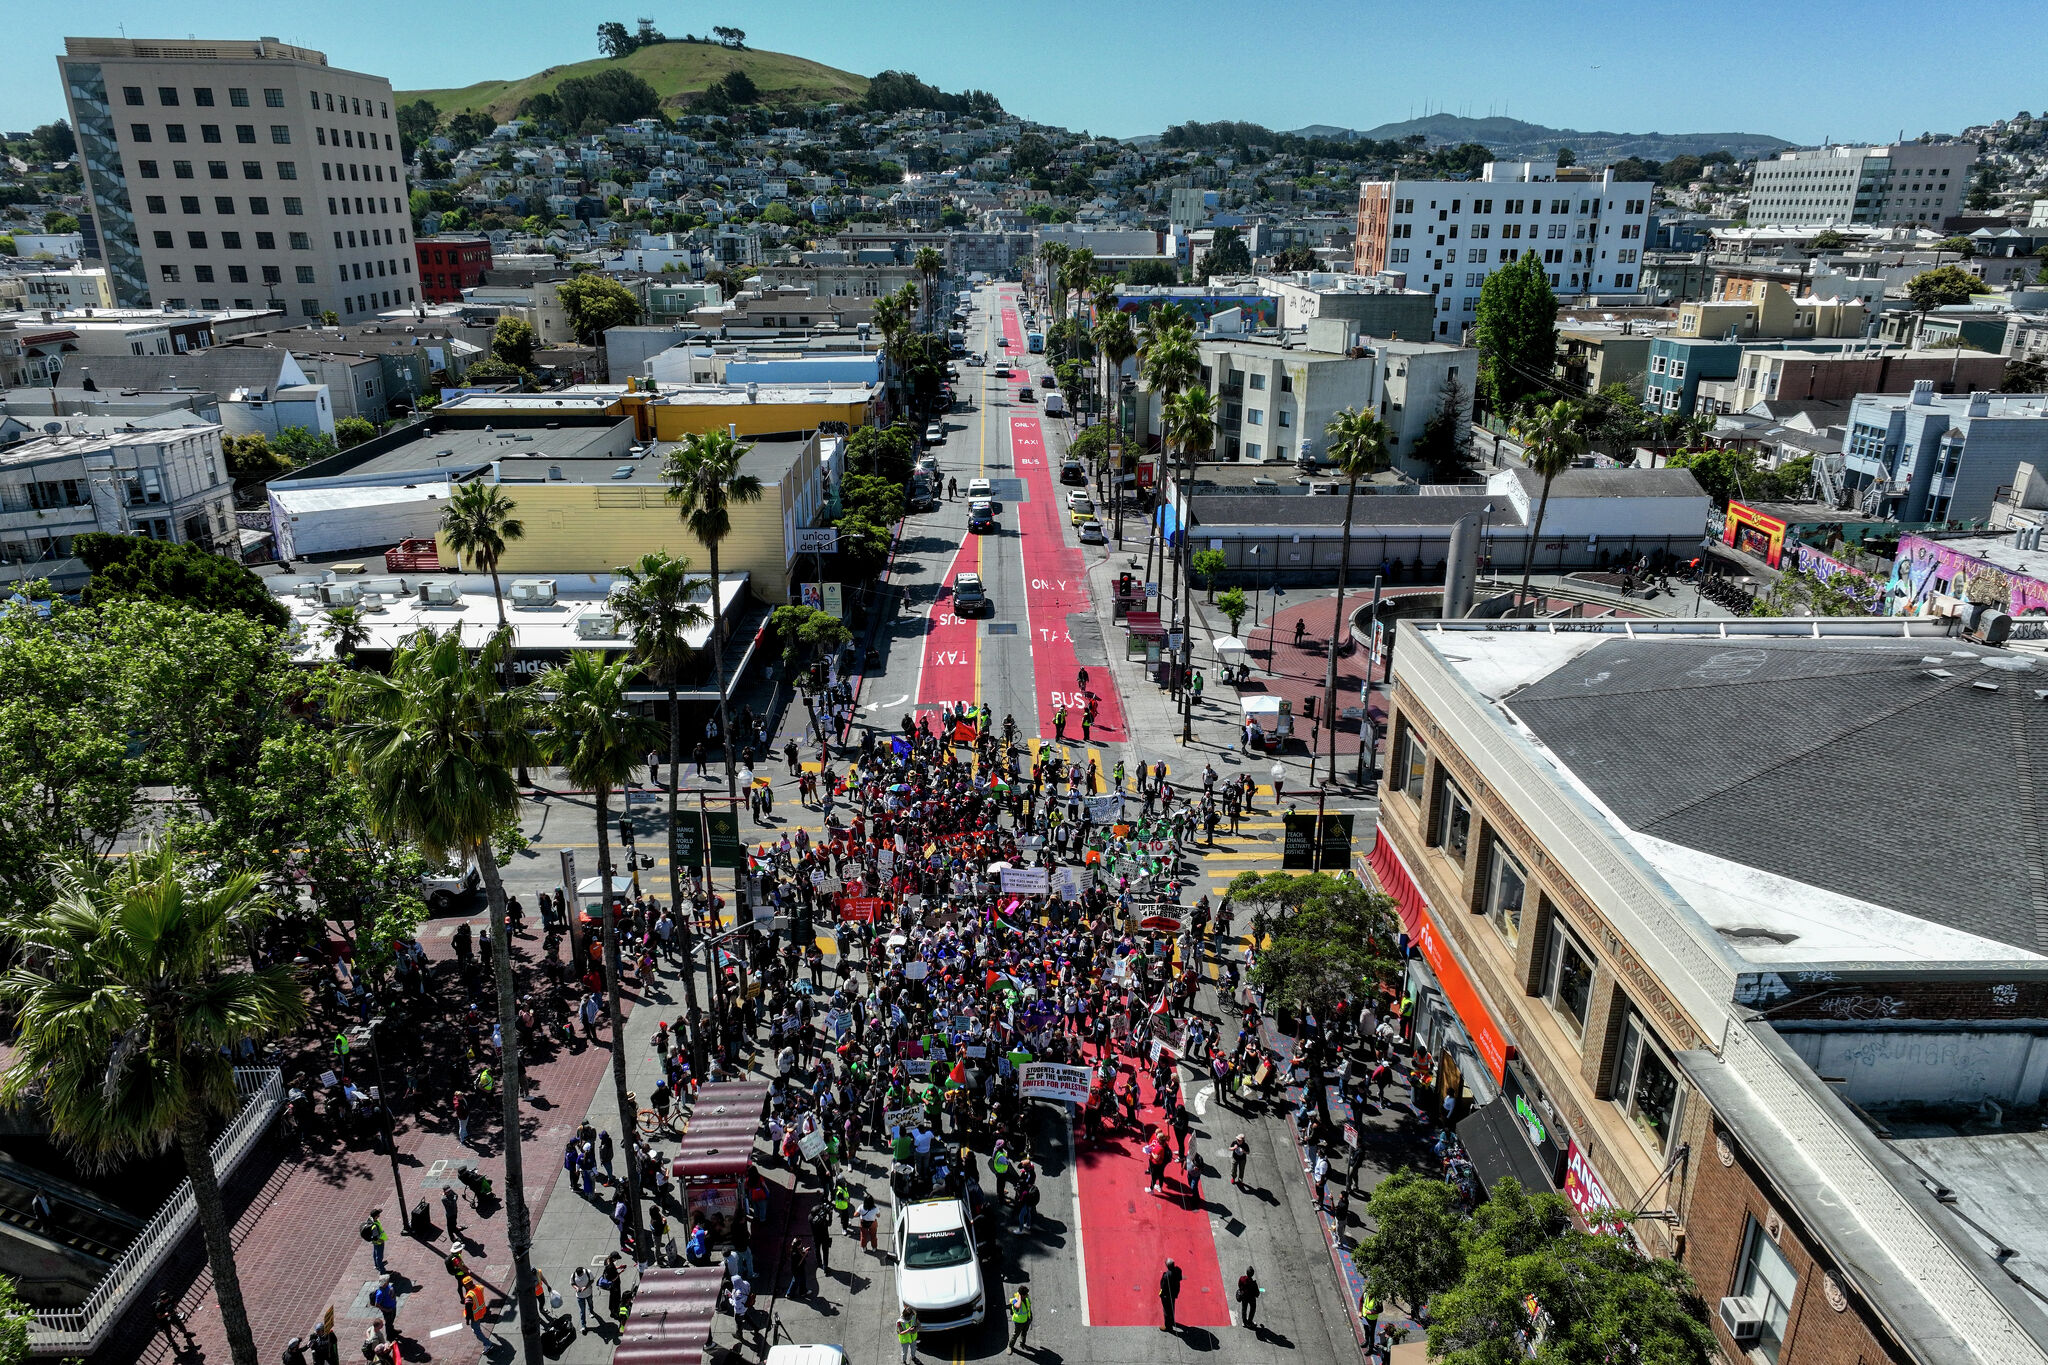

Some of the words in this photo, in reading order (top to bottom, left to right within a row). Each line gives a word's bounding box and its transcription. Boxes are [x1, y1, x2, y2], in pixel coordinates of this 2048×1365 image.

[803, 531, 830, 540] unica
[1939, 550, 1950, 565] LA
[1032, 579, 1066, 590] ONY
[1051, 692, 1085, 708] BUS
[1156, 904, 1188, 914] MEMBERS
[1421, 923, 1433, 955] ria
[1062, 1069, 1086, 1078] WORKERS
[1060, 1082, 1088, 1093] PALESTINE
